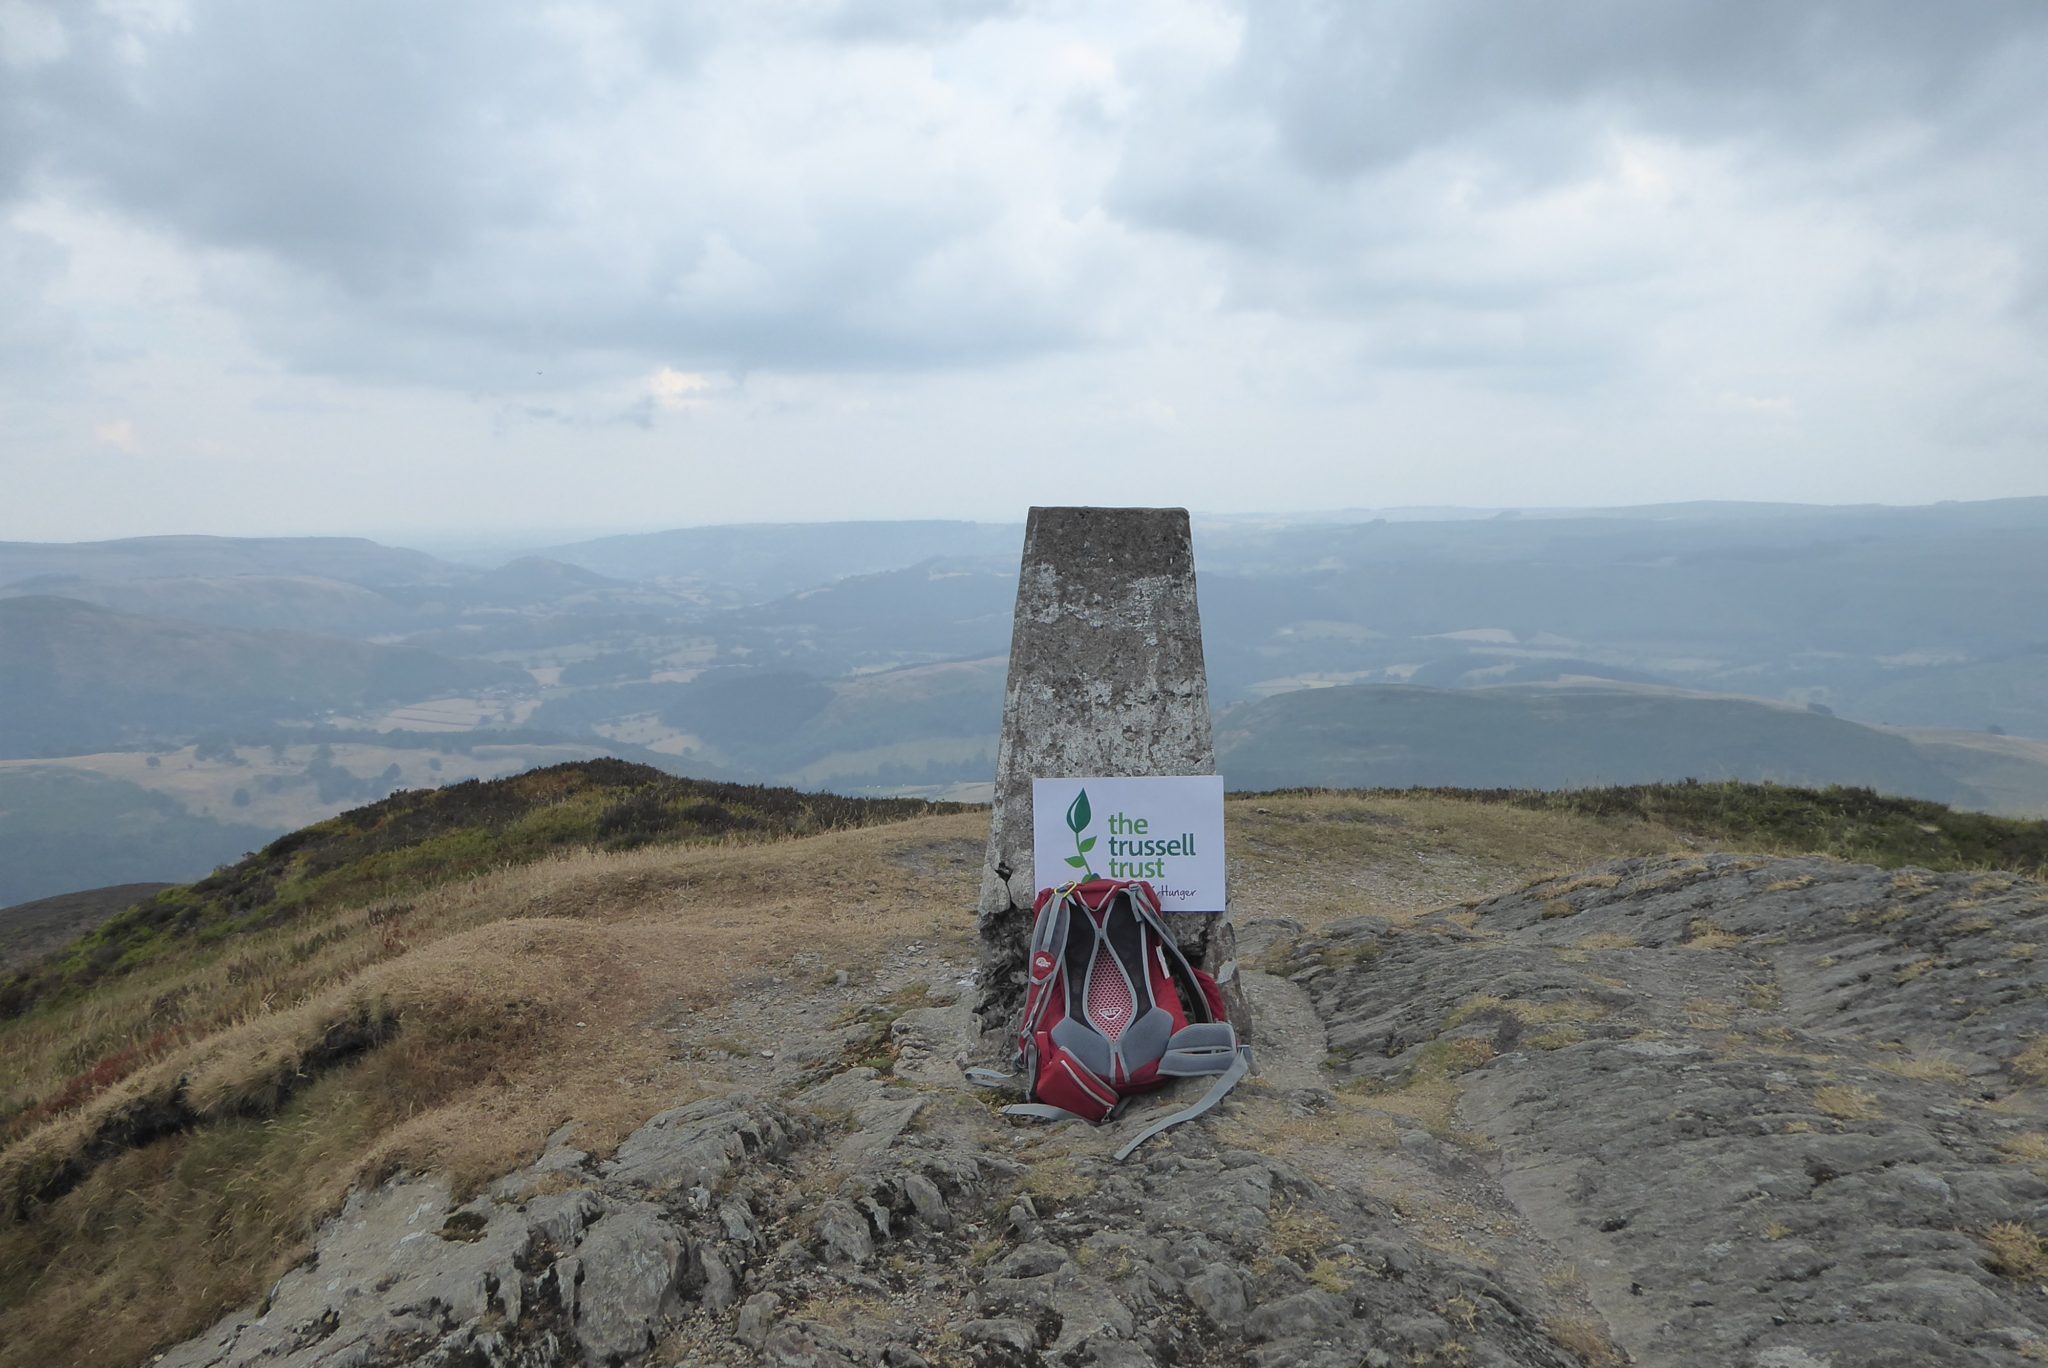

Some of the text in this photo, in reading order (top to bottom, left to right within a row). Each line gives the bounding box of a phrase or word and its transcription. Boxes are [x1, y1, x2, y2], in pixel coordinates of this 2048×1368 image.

[1108, 812, 1148, 835] the
[1108, 833, 1196, 856] trussell
[1108, 857, 1165, 879] trust
[1159, 884, 1197, 901] Hunger
